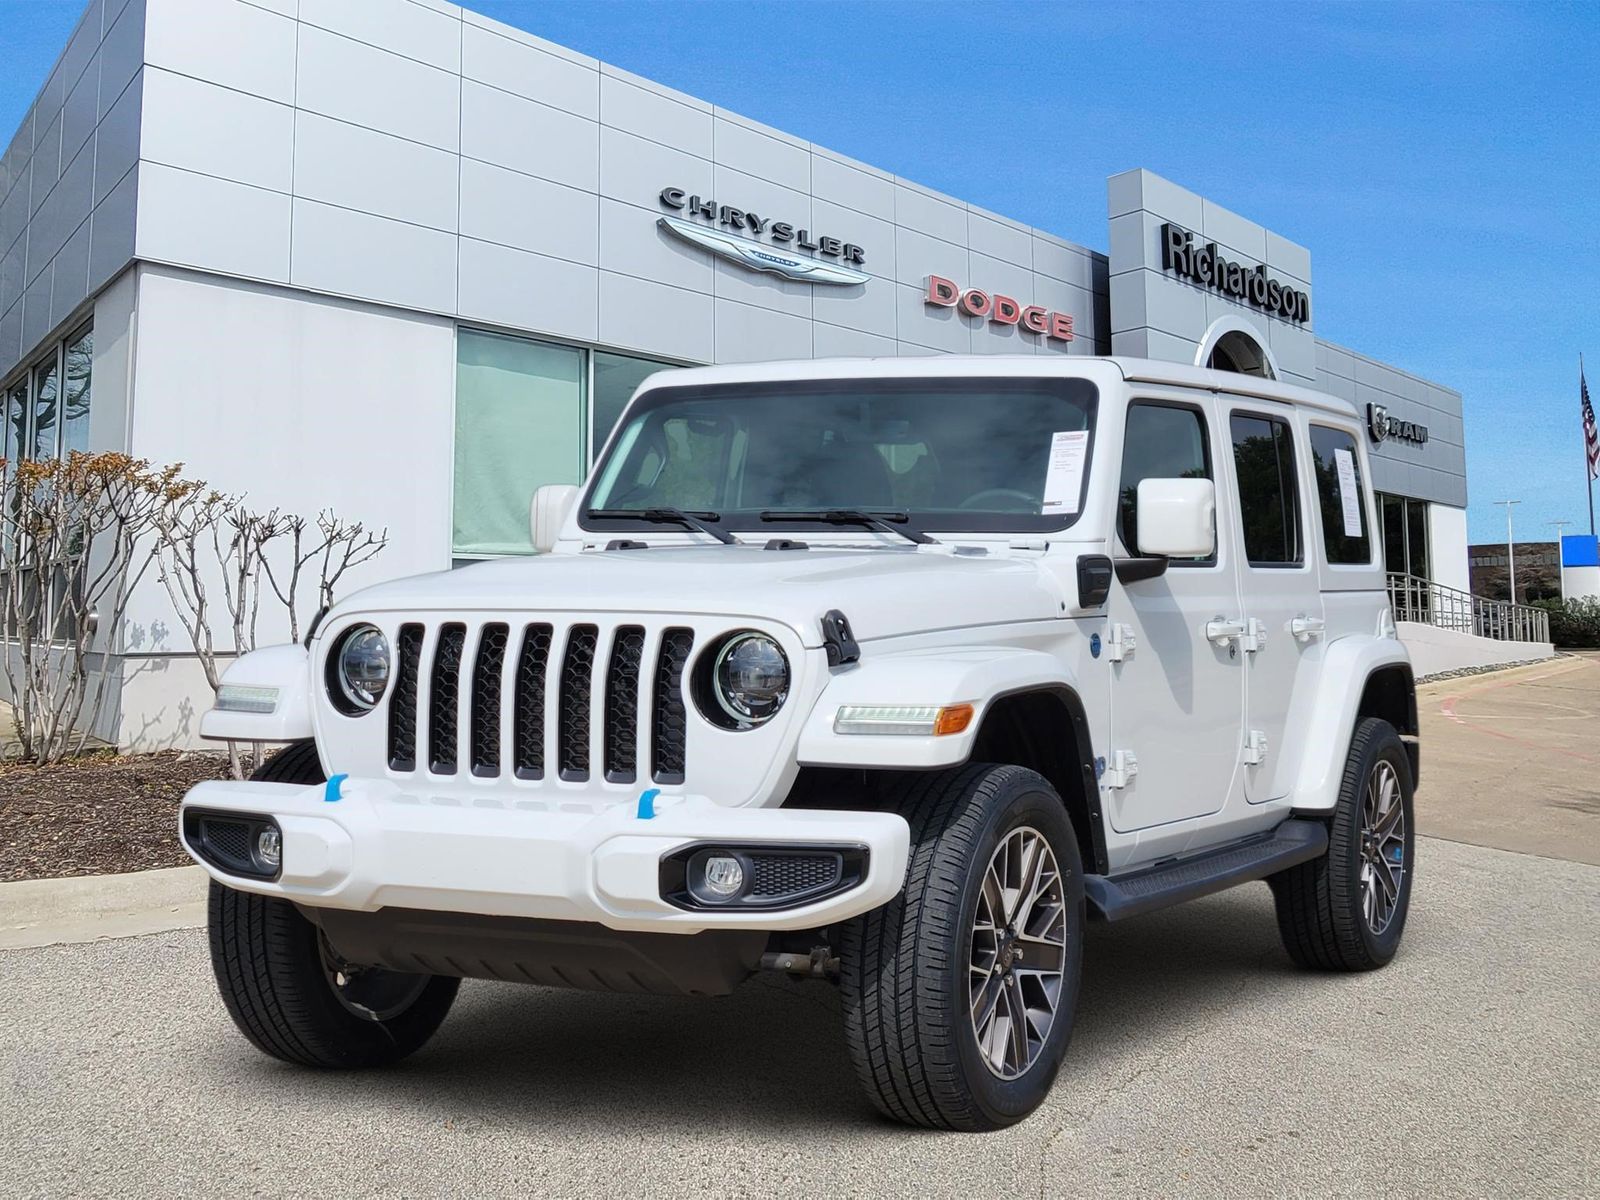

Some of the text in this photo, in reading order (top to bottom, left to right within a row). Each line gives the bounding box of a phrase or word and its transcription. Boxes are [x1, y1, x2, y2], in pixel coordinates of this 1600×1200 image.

[659, 186, 866, 264] CHRYSLER
[924, 274, 1074, 342] DODGE
[1160, 222, 1311, 323] Richardson
[1387, 416, 1428, 443] RAM
